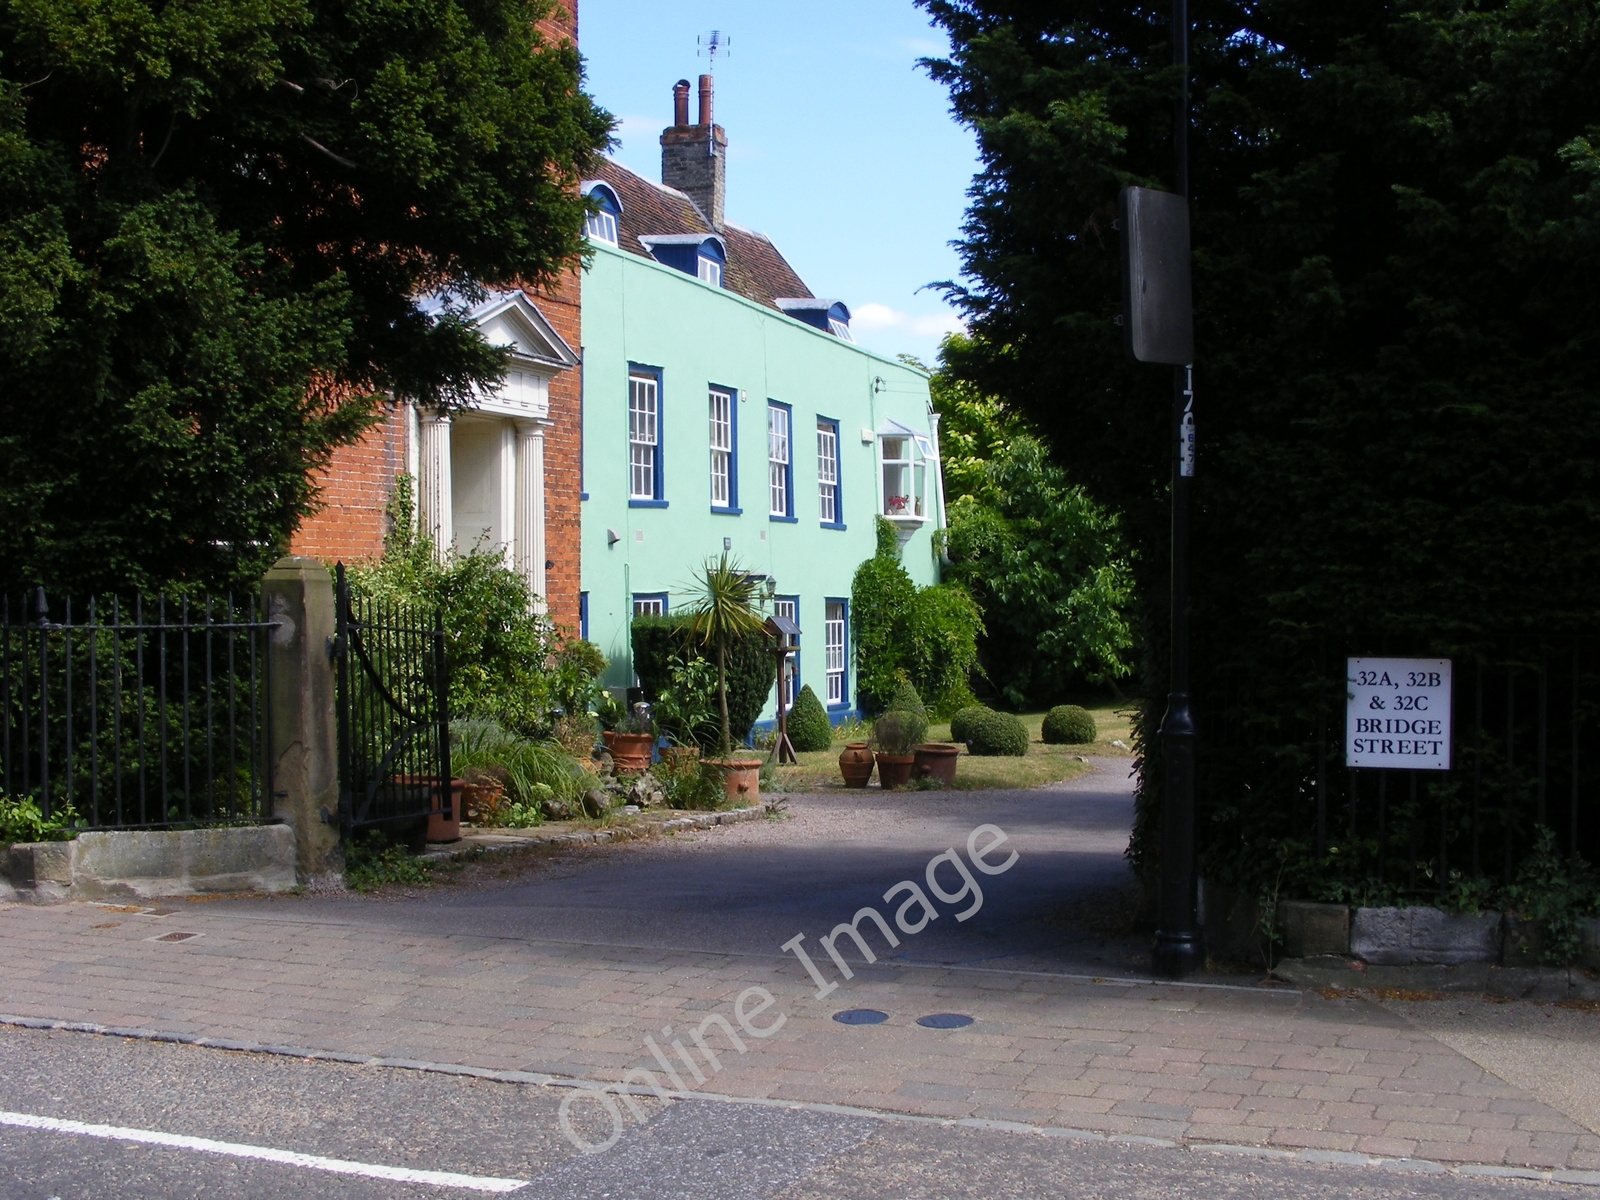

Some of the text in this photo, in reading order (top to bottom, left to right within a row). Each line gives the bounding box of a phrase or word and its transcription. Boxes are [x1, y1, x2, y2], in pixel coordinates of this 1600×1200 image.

[1357, 671, 1441, 690] 32A, 32B
[1369, 695, 1428, 711] & 32C
[1355, 718, 1442, 735] BRIDGE
[1353, 738, 1443, 755] STREET
